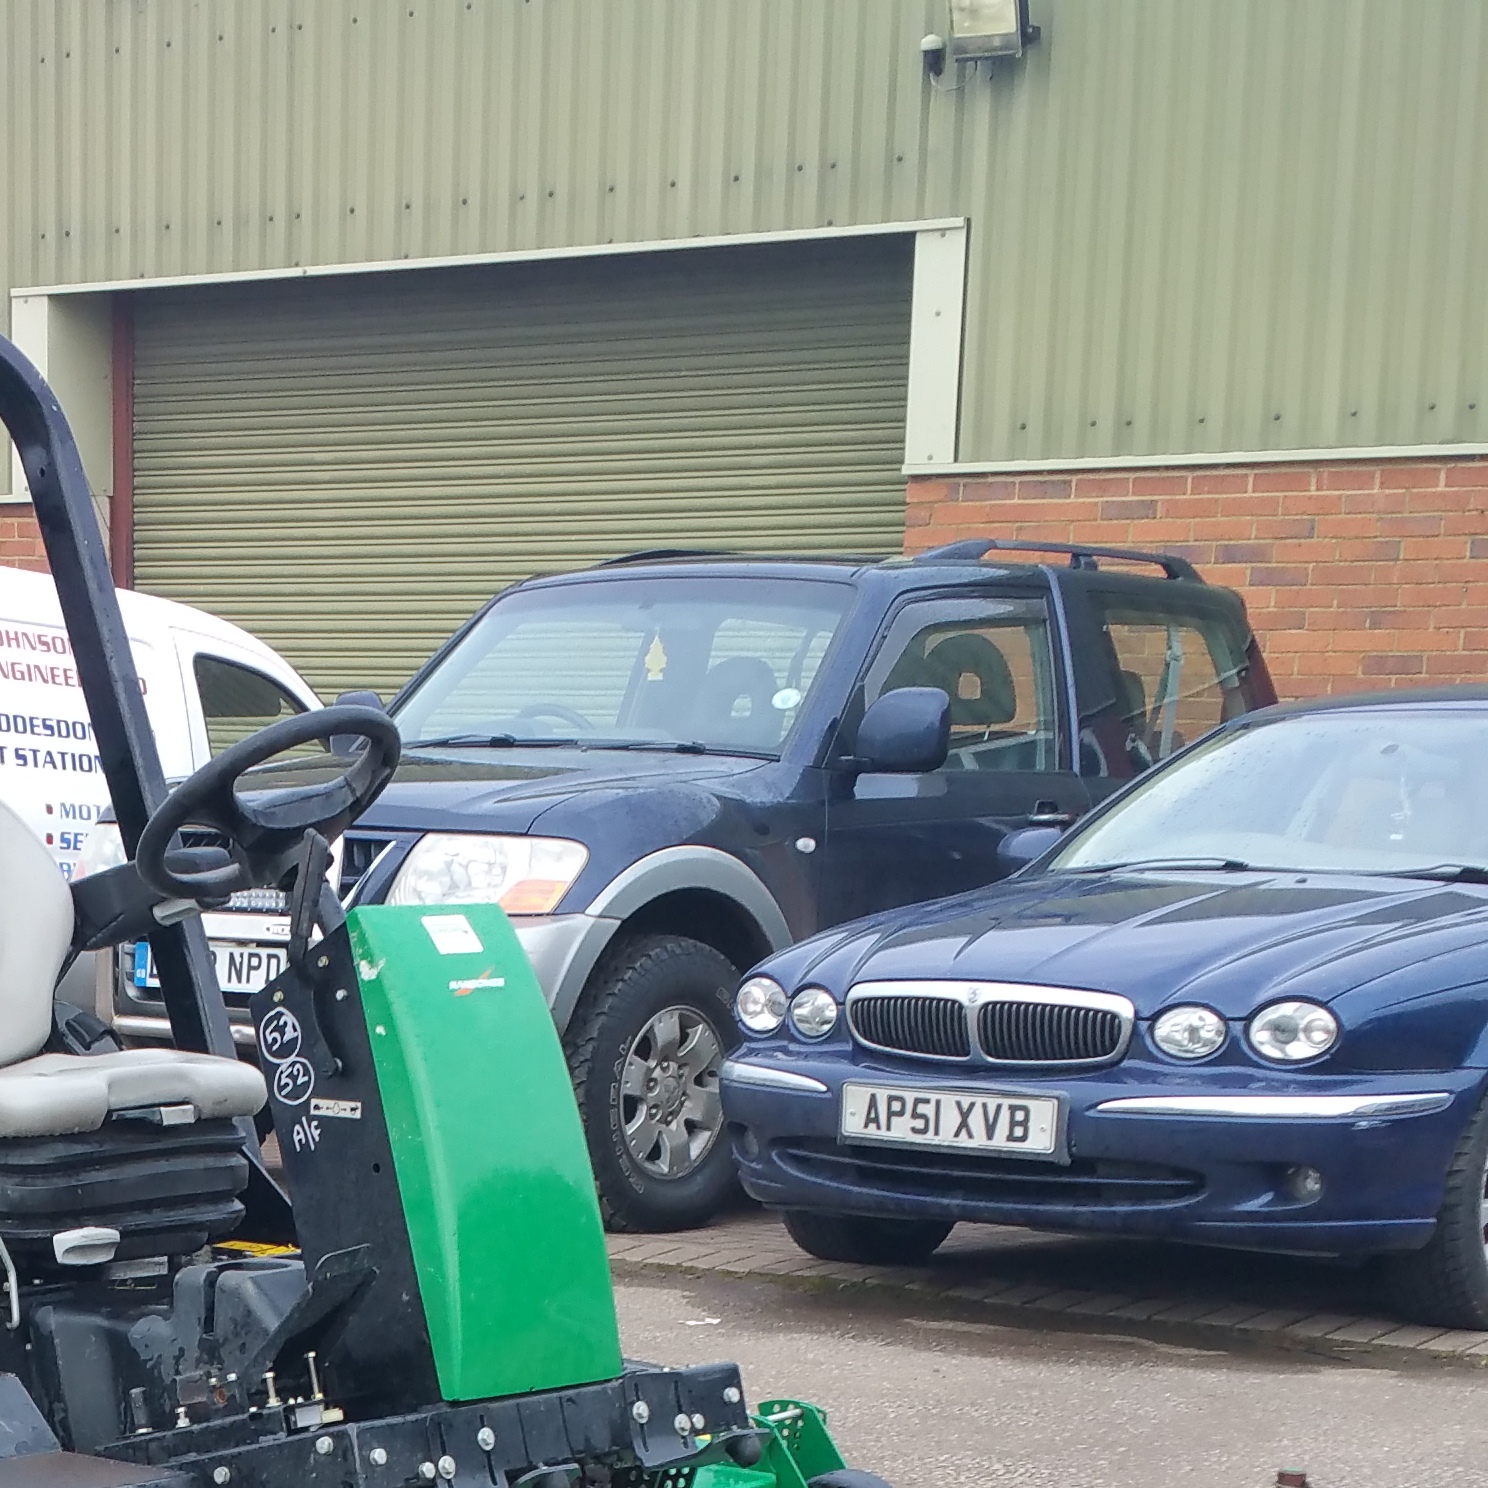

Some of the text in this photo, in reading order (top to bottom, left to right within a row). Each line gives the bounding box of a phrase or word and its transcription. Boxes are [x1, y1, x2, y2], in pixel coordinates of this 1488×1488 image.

[226, 951, 281, 985] NPD
[264, 1014, 299, 1052] 52
[279, 1062, 309, 1096] 52
[863, 1092, 1041, 1143] AP51 XVB
